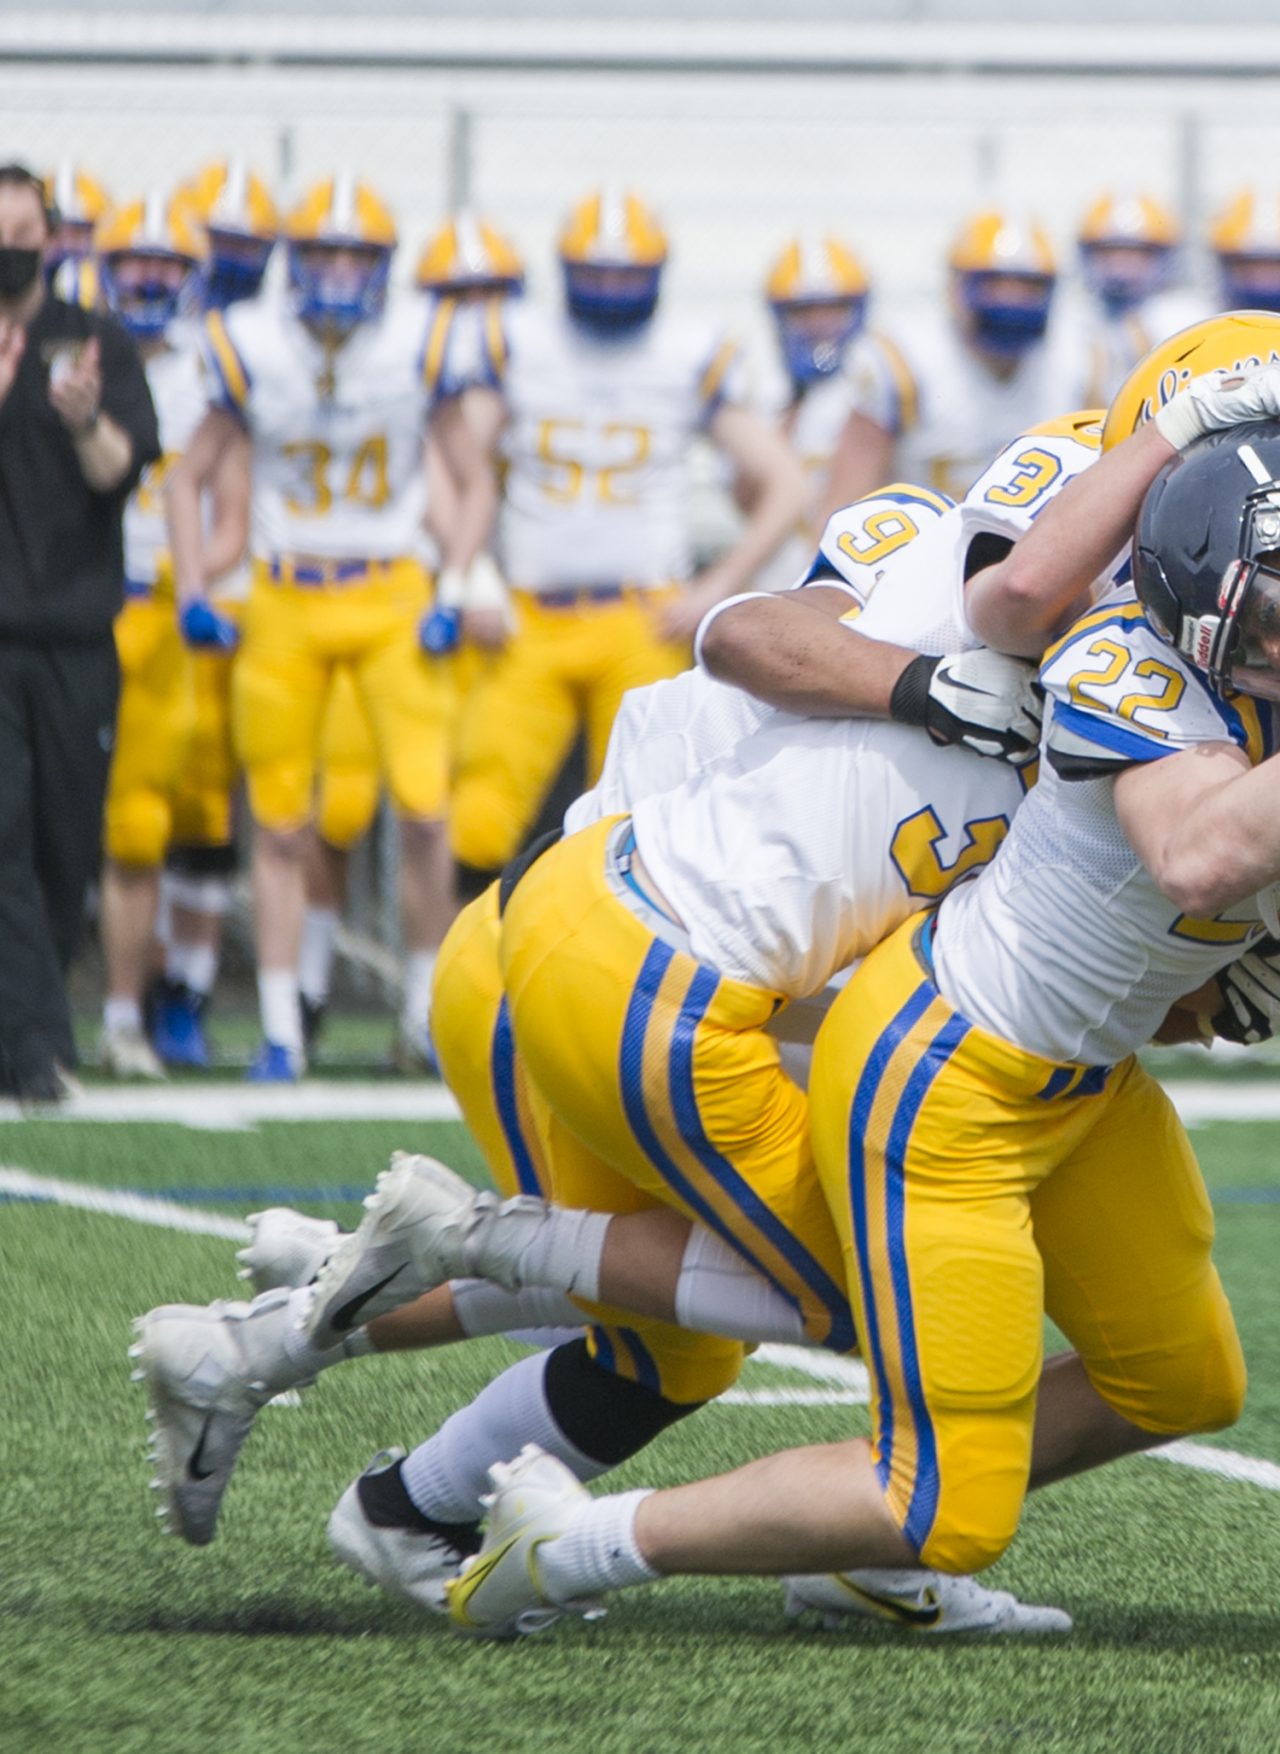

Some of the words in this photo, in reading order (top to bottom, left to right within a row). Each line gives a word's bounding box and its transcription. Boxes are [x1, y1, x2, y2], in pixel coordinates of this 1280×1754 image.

[280, 432, 390, 519] 34
[537, 419, 651, 504] 52
[984, 447, 1078, 520] 3
[837, 509, 919, 581] 9
[1067, 638, 1187, 739] 22
